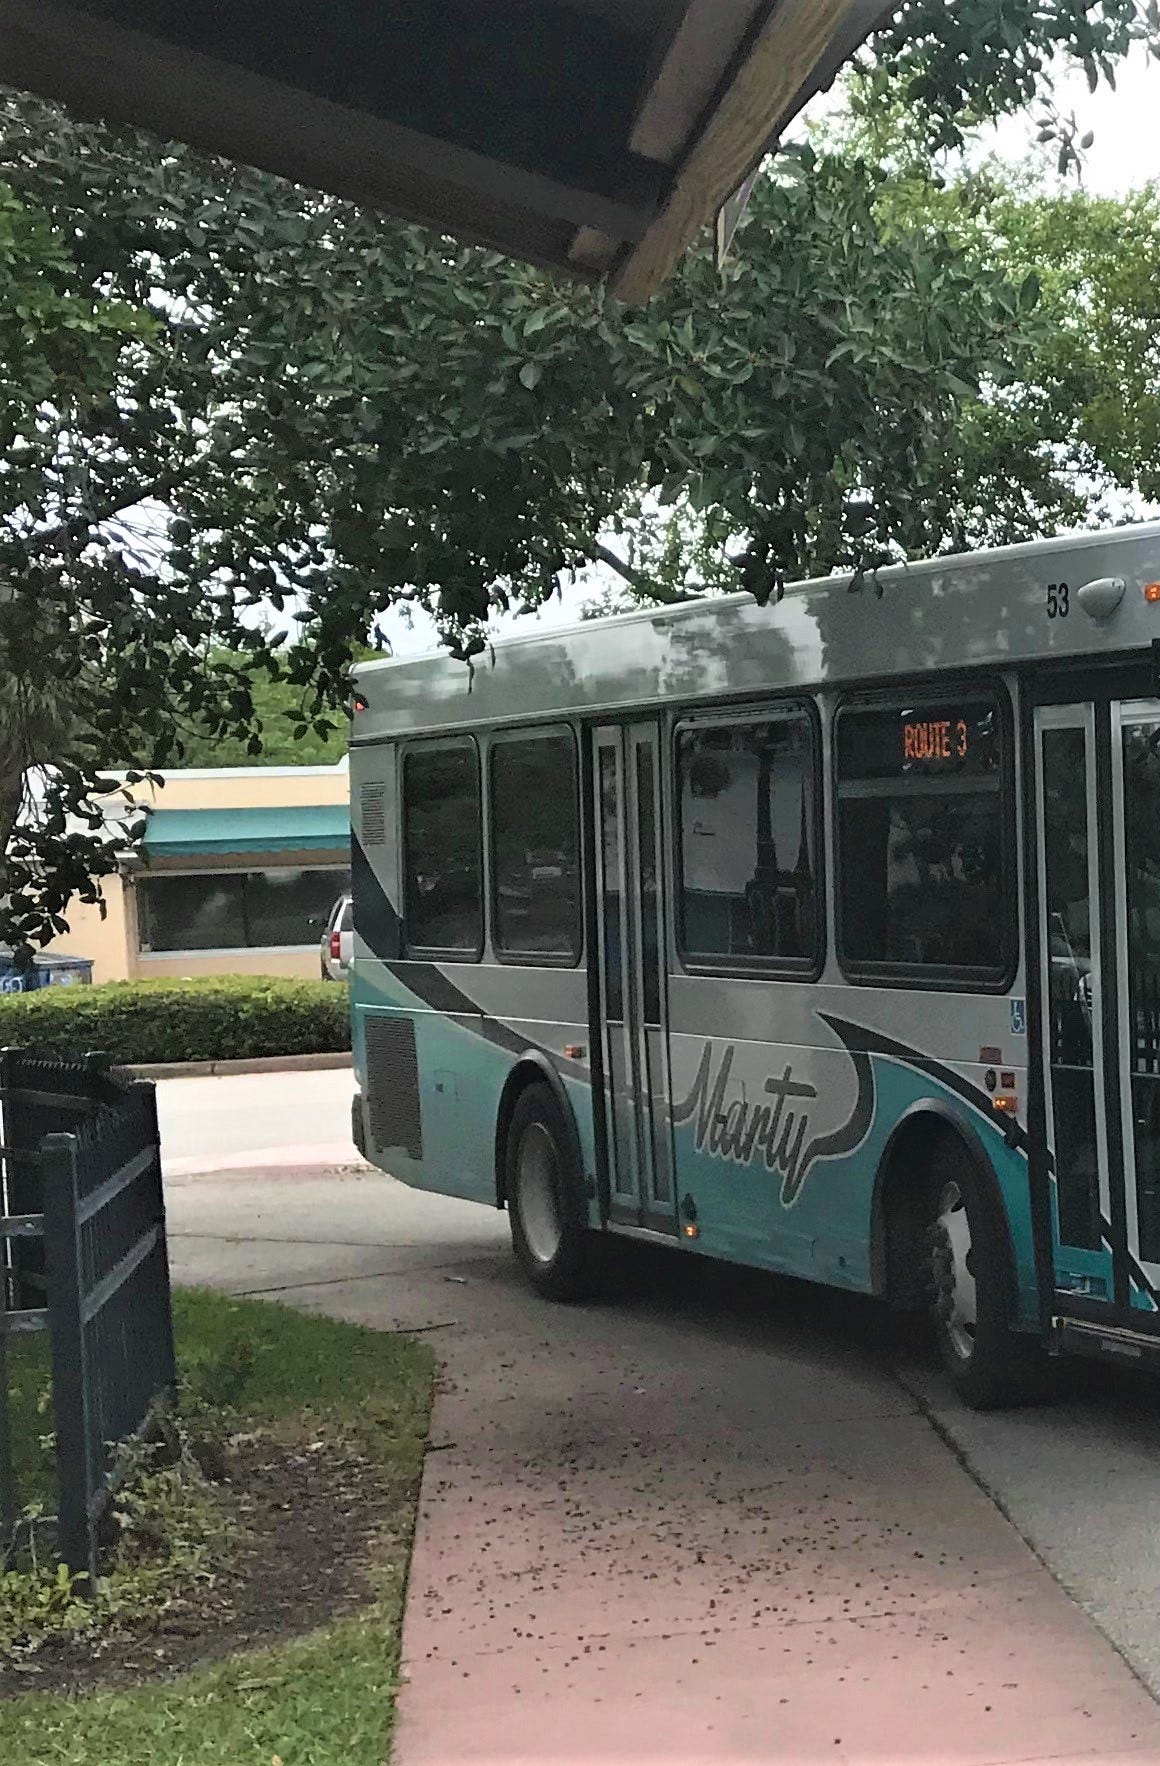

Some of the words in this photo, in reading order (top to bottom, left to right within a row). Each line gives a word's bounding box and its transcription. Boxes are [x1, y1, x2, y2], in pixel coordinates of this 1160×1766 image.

[1046, 582, 1070, 618] 53
[904, 721, 951, 758] ROUTE
[956, 720, 967, 756] 3
[667, 1041, 818, 1208] Marty
